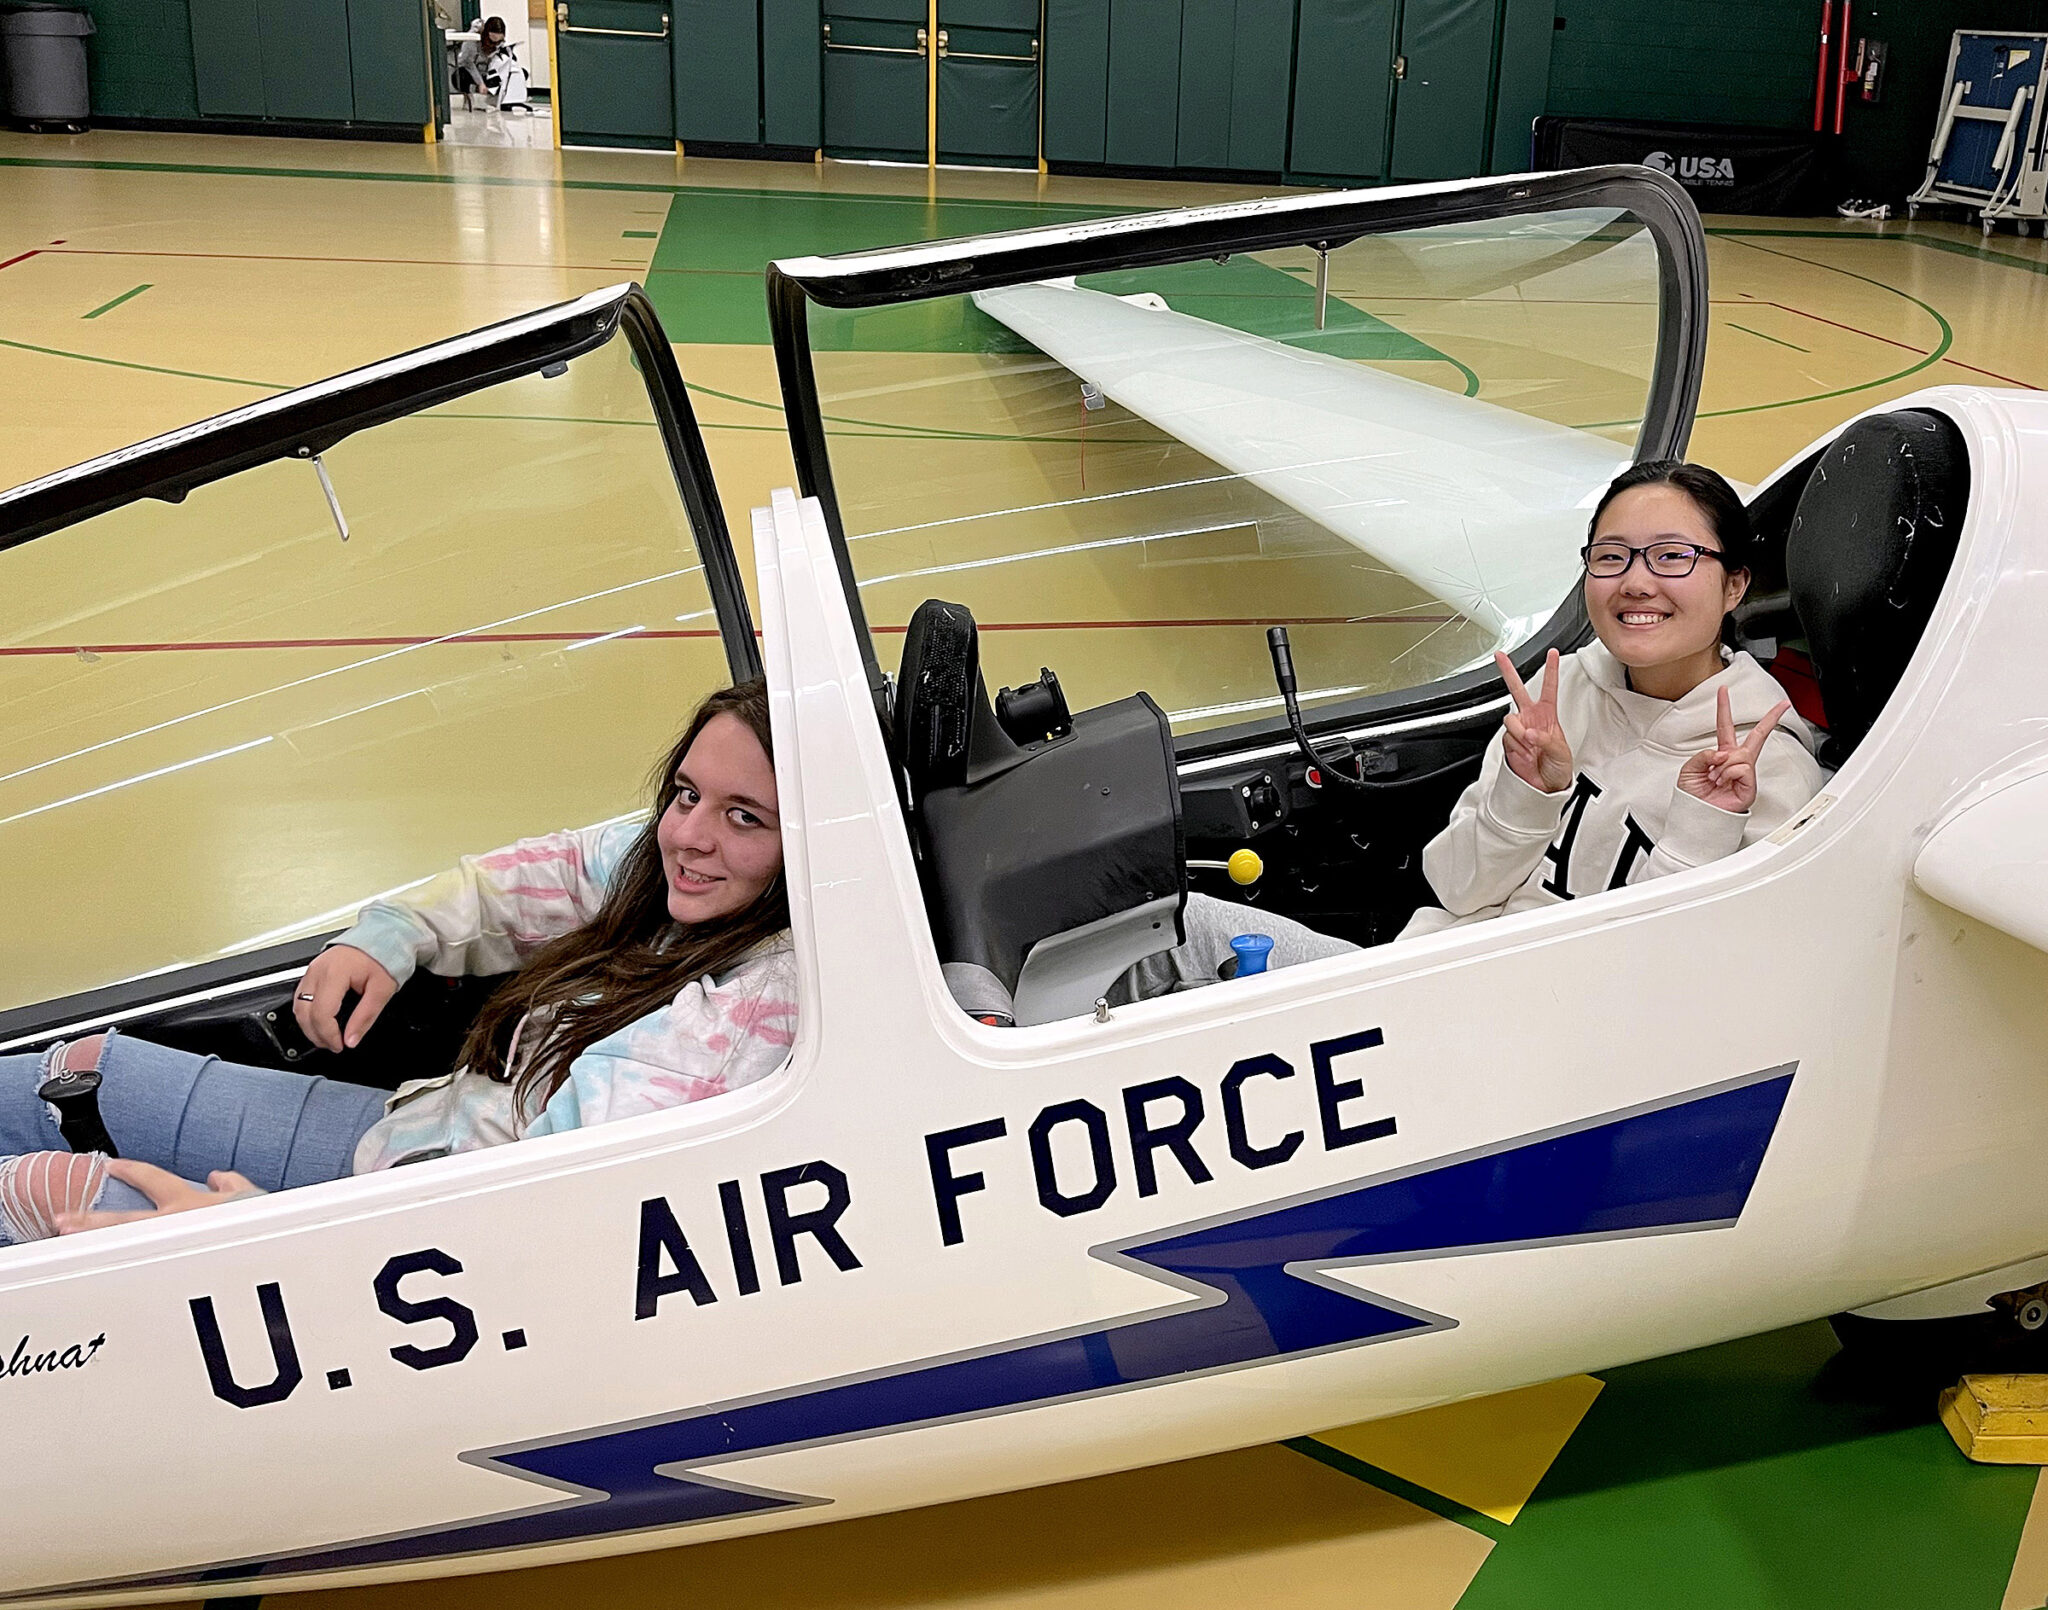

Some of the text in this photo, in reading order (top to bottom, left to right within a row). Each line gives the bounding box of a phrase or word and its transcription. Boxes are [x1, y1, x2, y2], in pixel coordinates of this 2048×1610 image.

[1680, 157, 1735, 178] USA
[188, 1027, 1398, 1409] U.S. AIR FORCE
